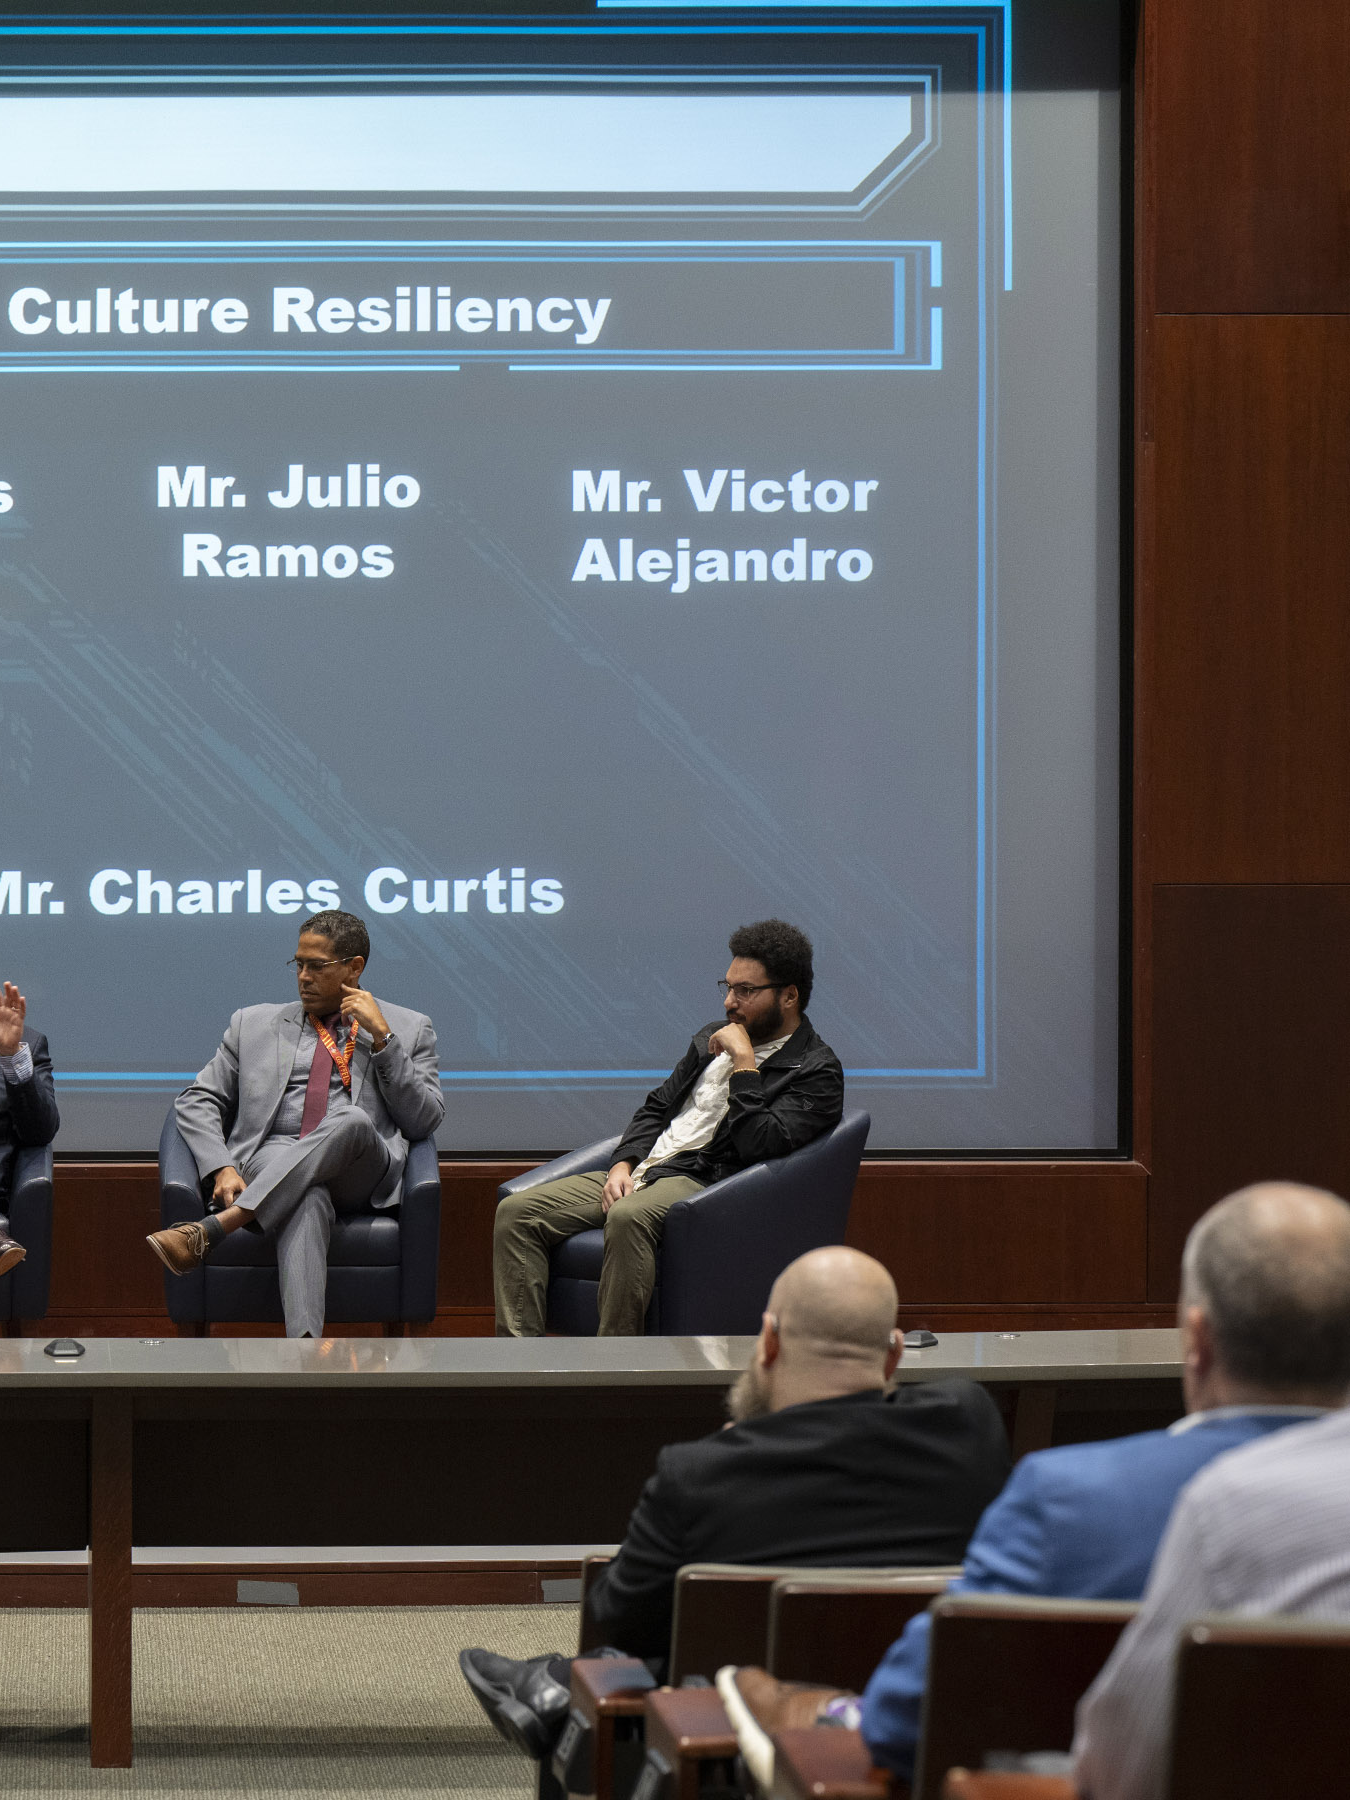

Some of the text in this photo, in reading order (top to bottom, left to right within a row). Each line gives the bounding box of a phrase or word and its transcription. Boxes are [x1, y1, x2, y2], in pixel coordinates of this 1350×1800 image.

[9, 288, 248, 335] Culture
[274, 287, 612, 345] Resiliency
[157, 464, 421, 508] Mr. Julio
[572, 470, 879, 512] Mr. Victor
[182, 534, 395, 579] Ramos
[571, 539, 874, 593] Alejandro
[89, 868, 341, 914] Charles
[365, 868, 565, 914] Curtis
